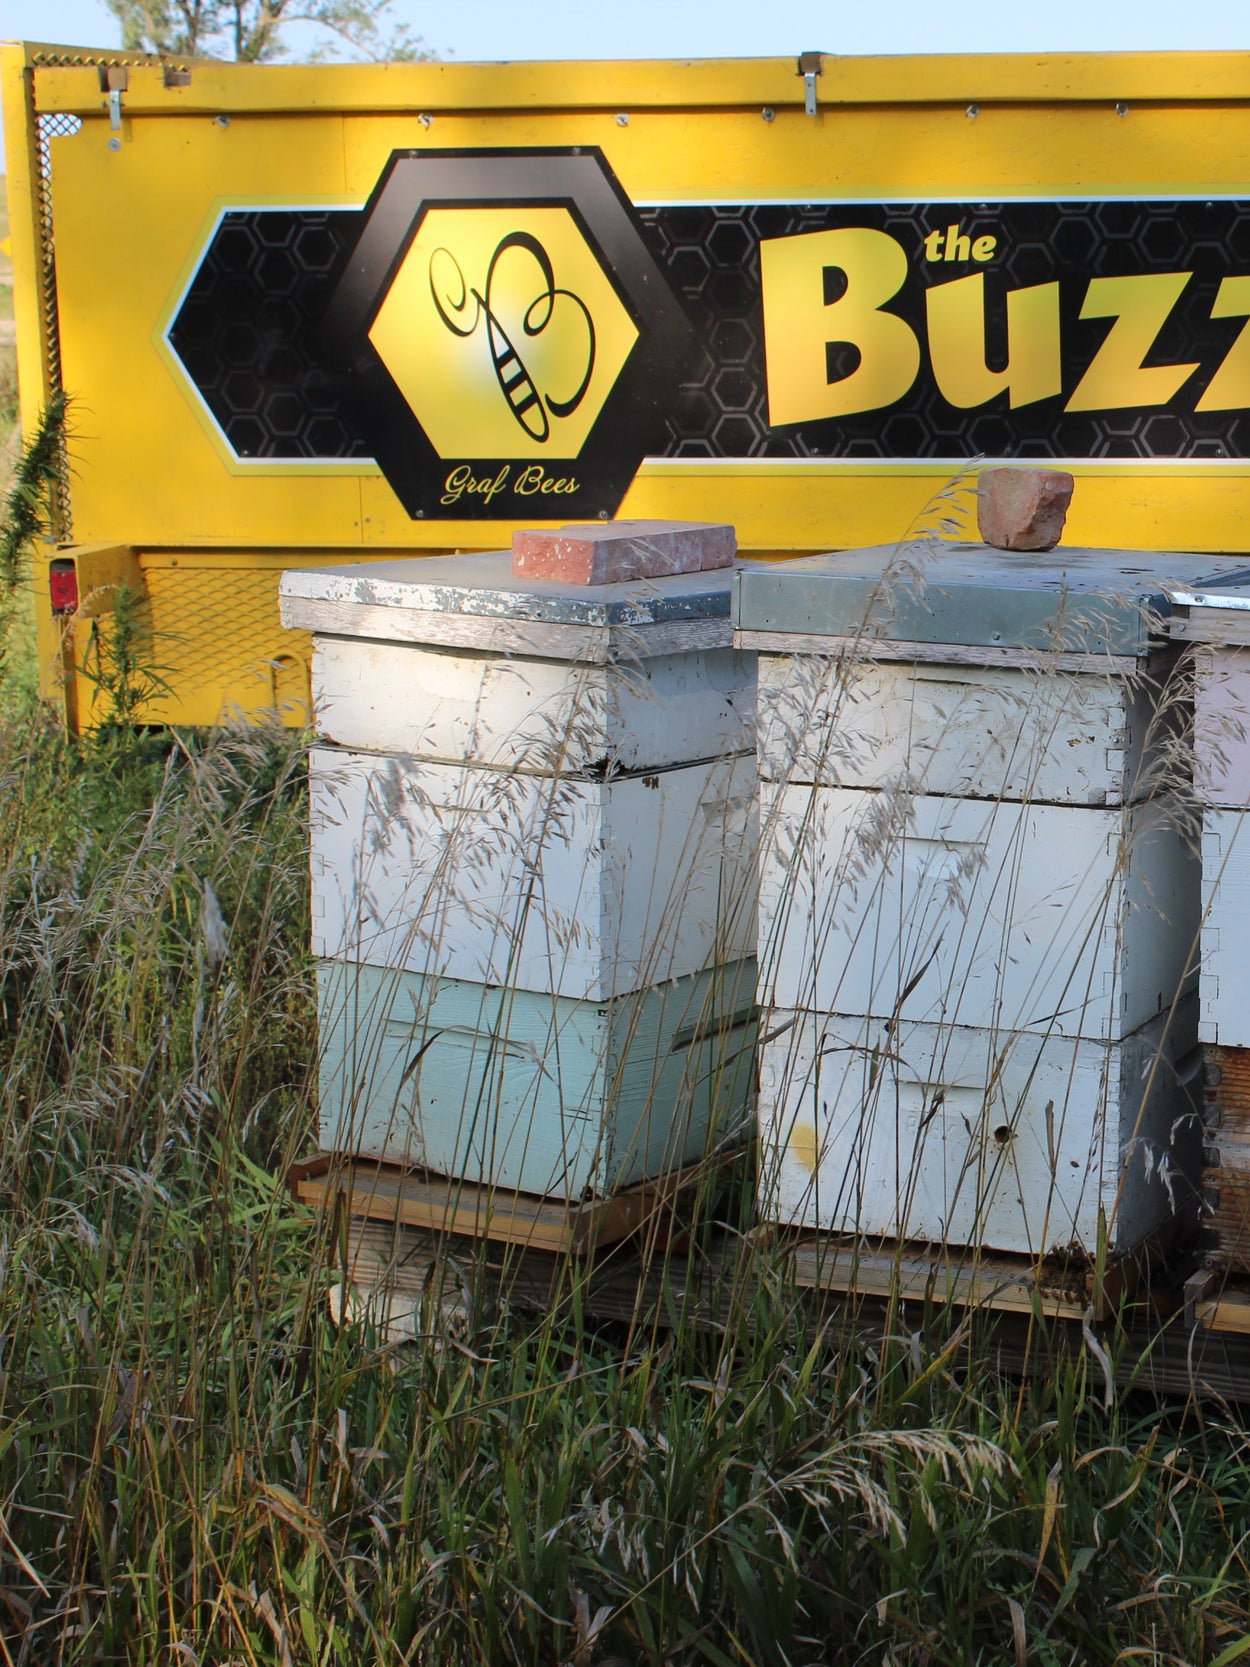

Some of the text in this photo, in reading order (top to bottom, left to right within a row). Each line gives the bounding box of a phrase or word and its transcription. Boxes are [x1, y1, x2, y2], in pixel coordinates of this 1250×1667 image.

[924, 224, 997, 262] the
[440, 465, 580, 504] Graf Bees
